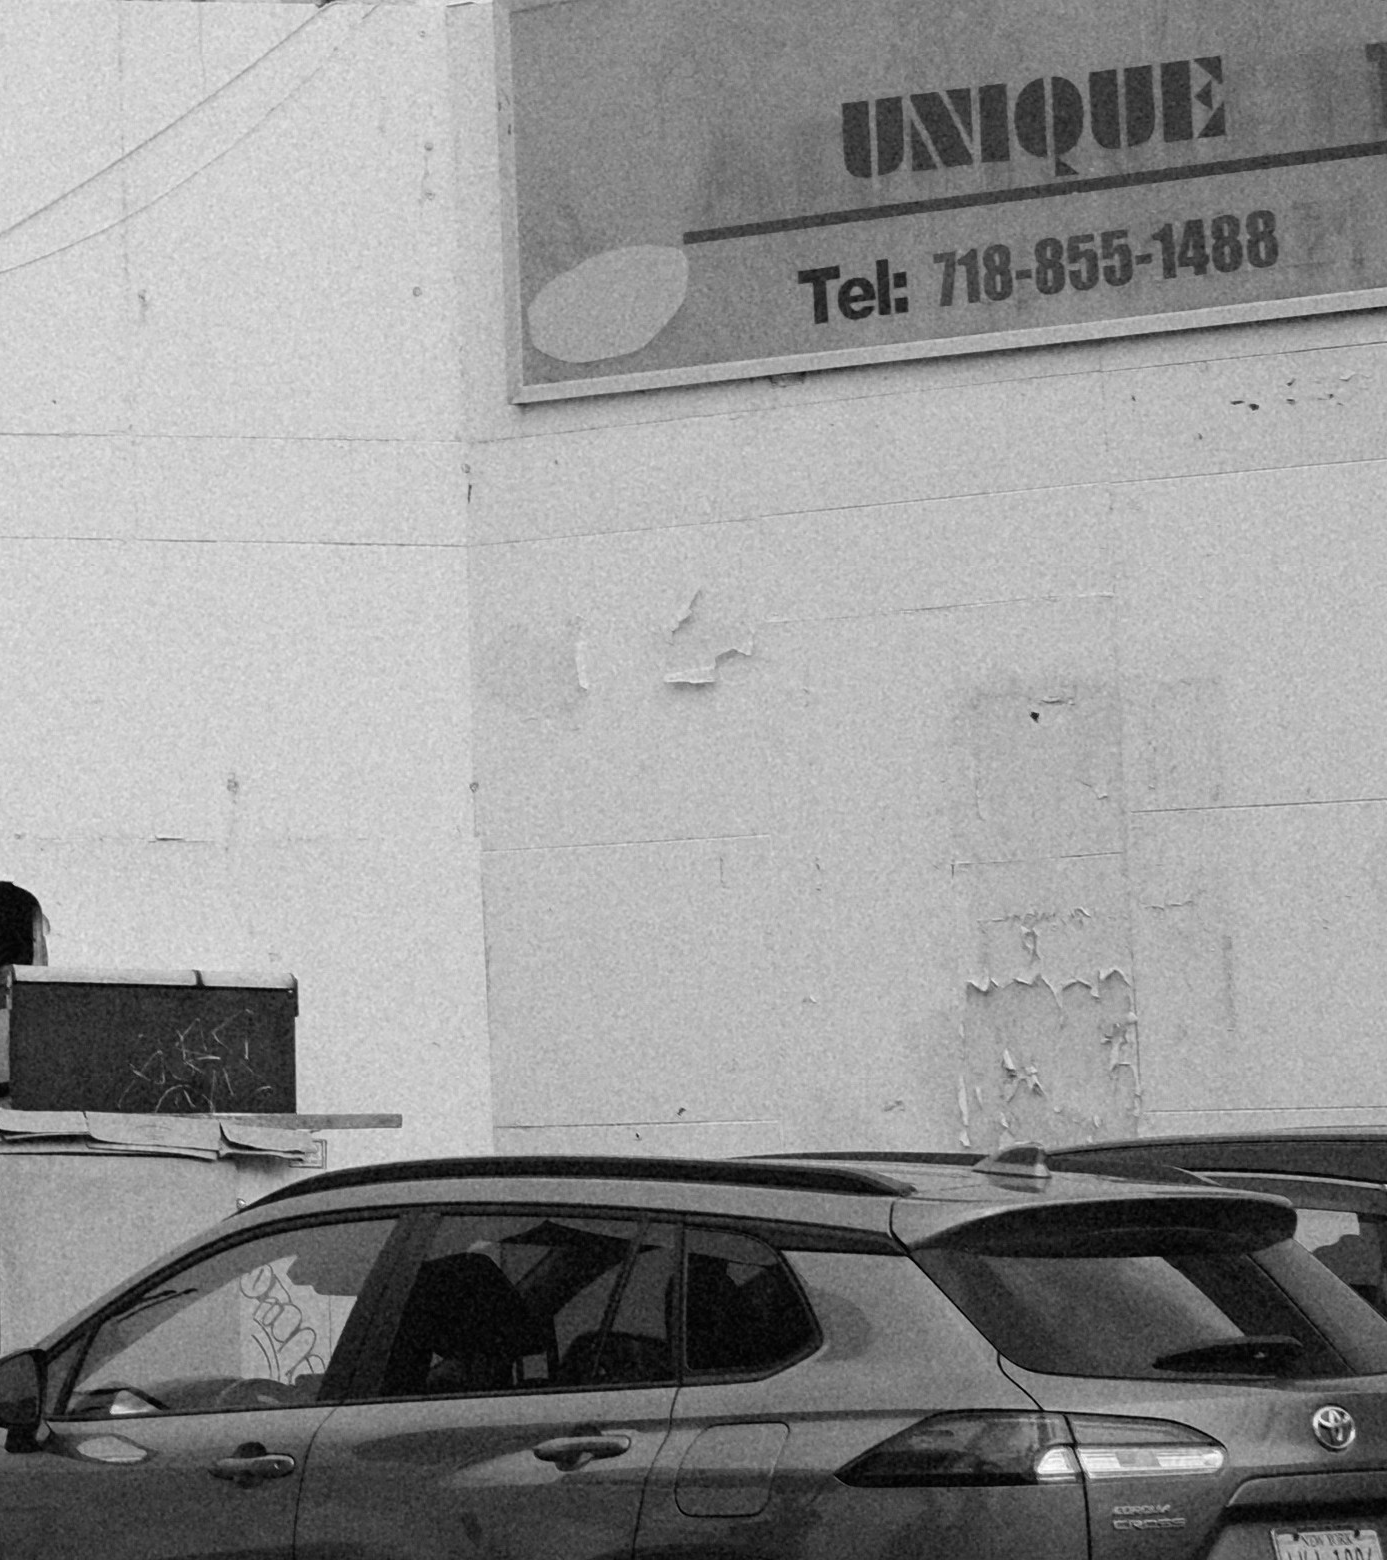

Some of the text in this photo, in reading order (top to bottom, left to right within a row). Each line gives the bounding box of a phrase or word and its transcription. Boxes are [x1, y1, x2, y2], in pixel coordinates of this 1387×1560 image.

[841, 55, 1227, 178] UNIQUE
[797, 210, 1279, 324] Tel: 718-855-1488
